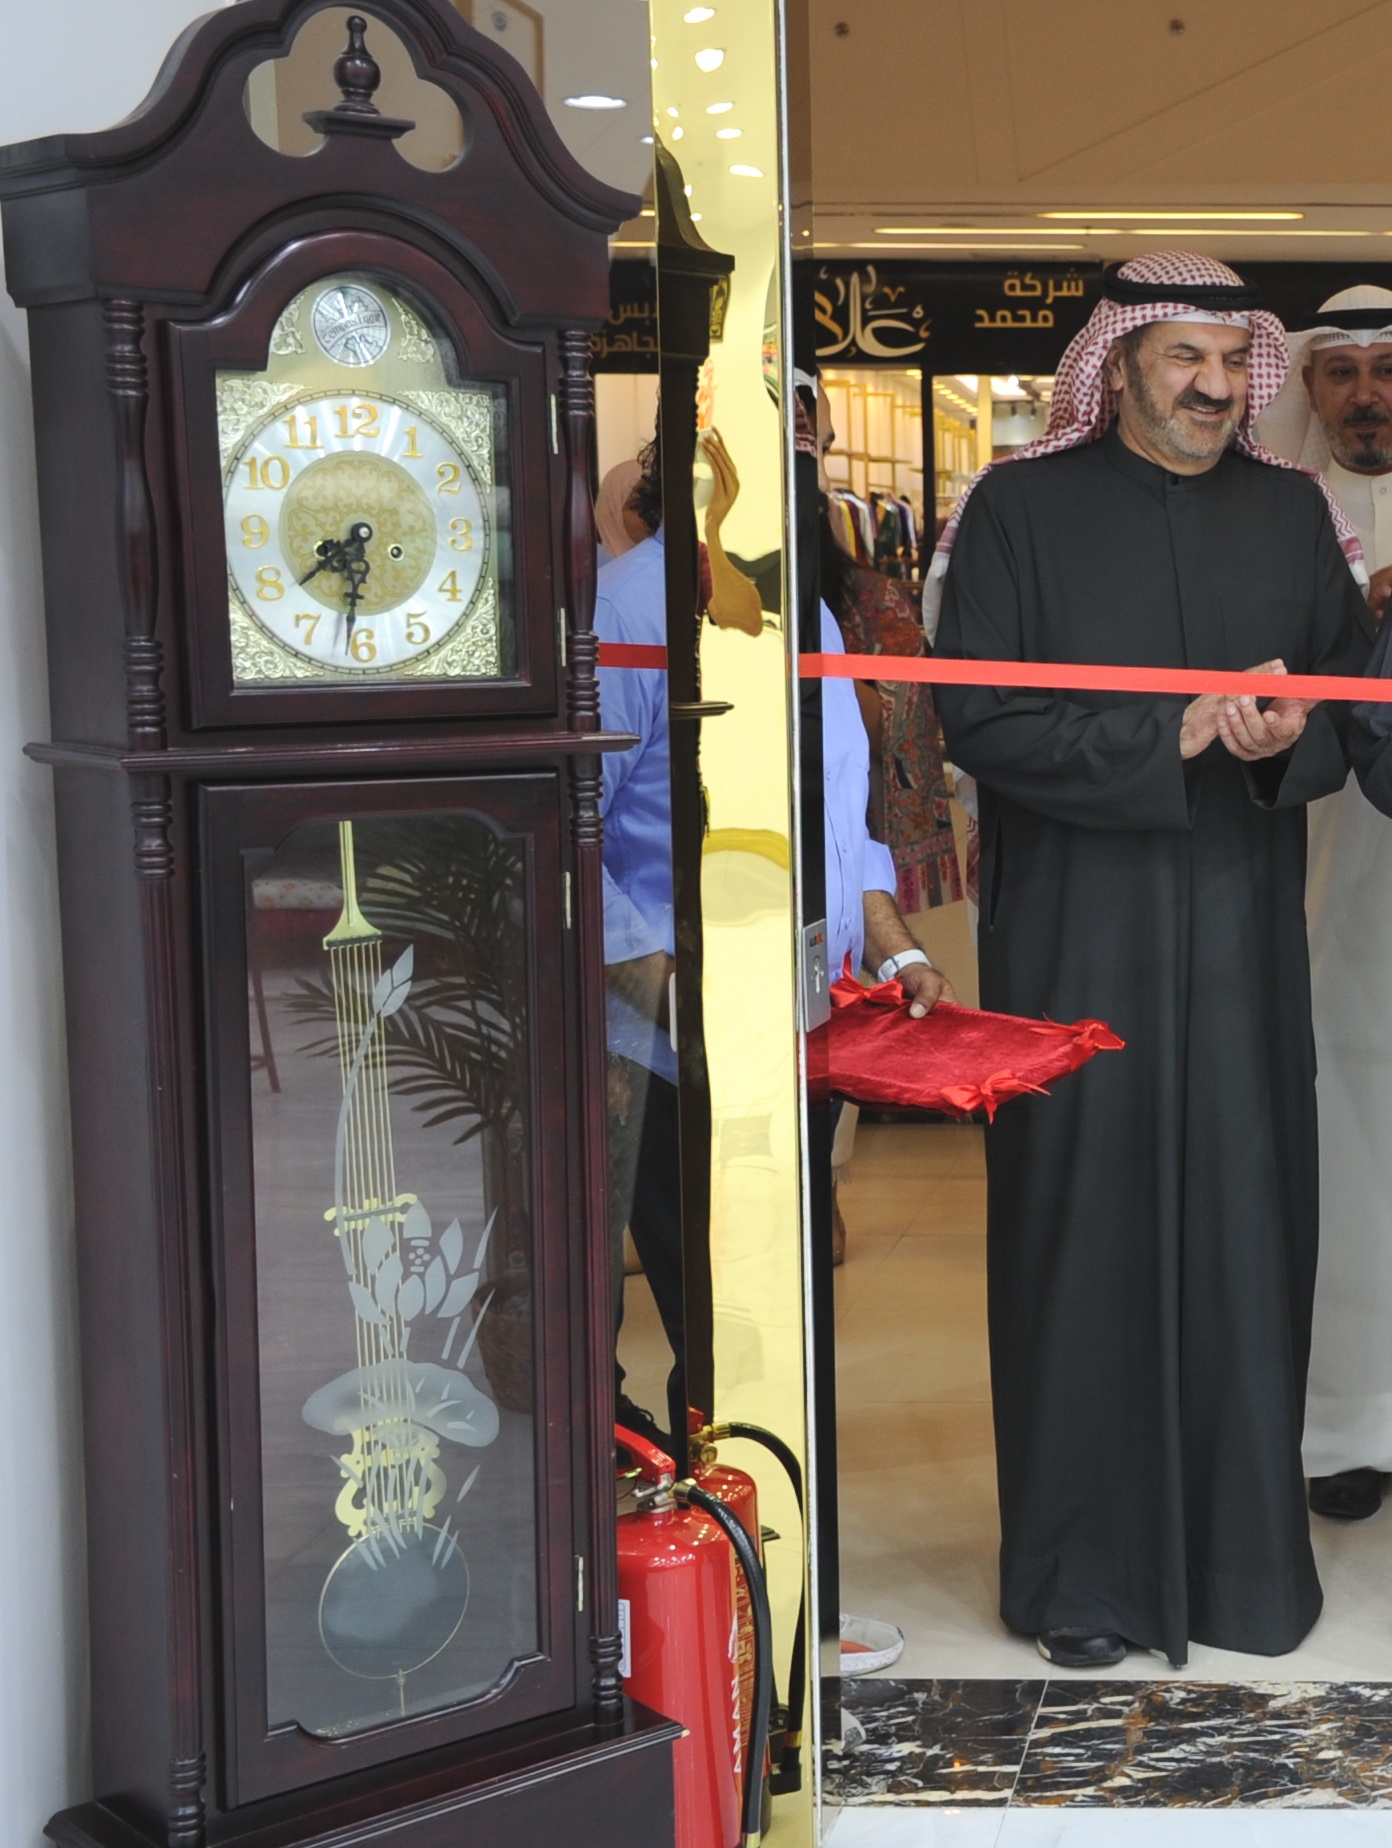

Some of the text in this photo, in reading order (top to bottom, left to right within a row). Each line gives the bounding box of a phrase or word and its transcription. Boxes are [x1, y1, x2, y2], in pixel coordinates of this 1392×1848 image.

[1004, 267, 1084, 304] شركة
[974, 309, 1054, 328] محمد
[284, 415, 323, 449] 11
[335, 404, 380, 438] 12
[404, 426, 422, 458] 1
[244, 456, 290, 490] 10
[437, 463, 462, 495] 2
[241, 514, 269, 548] 9
[450, 518, 473, 551] 3
[256, 567, 284, 601] 8
[438, 570, 463, 602] 4
[295, 613, 321, 644] 7
[406, 612, 430, 644] 5
[351, 629, 376, 662] 6
